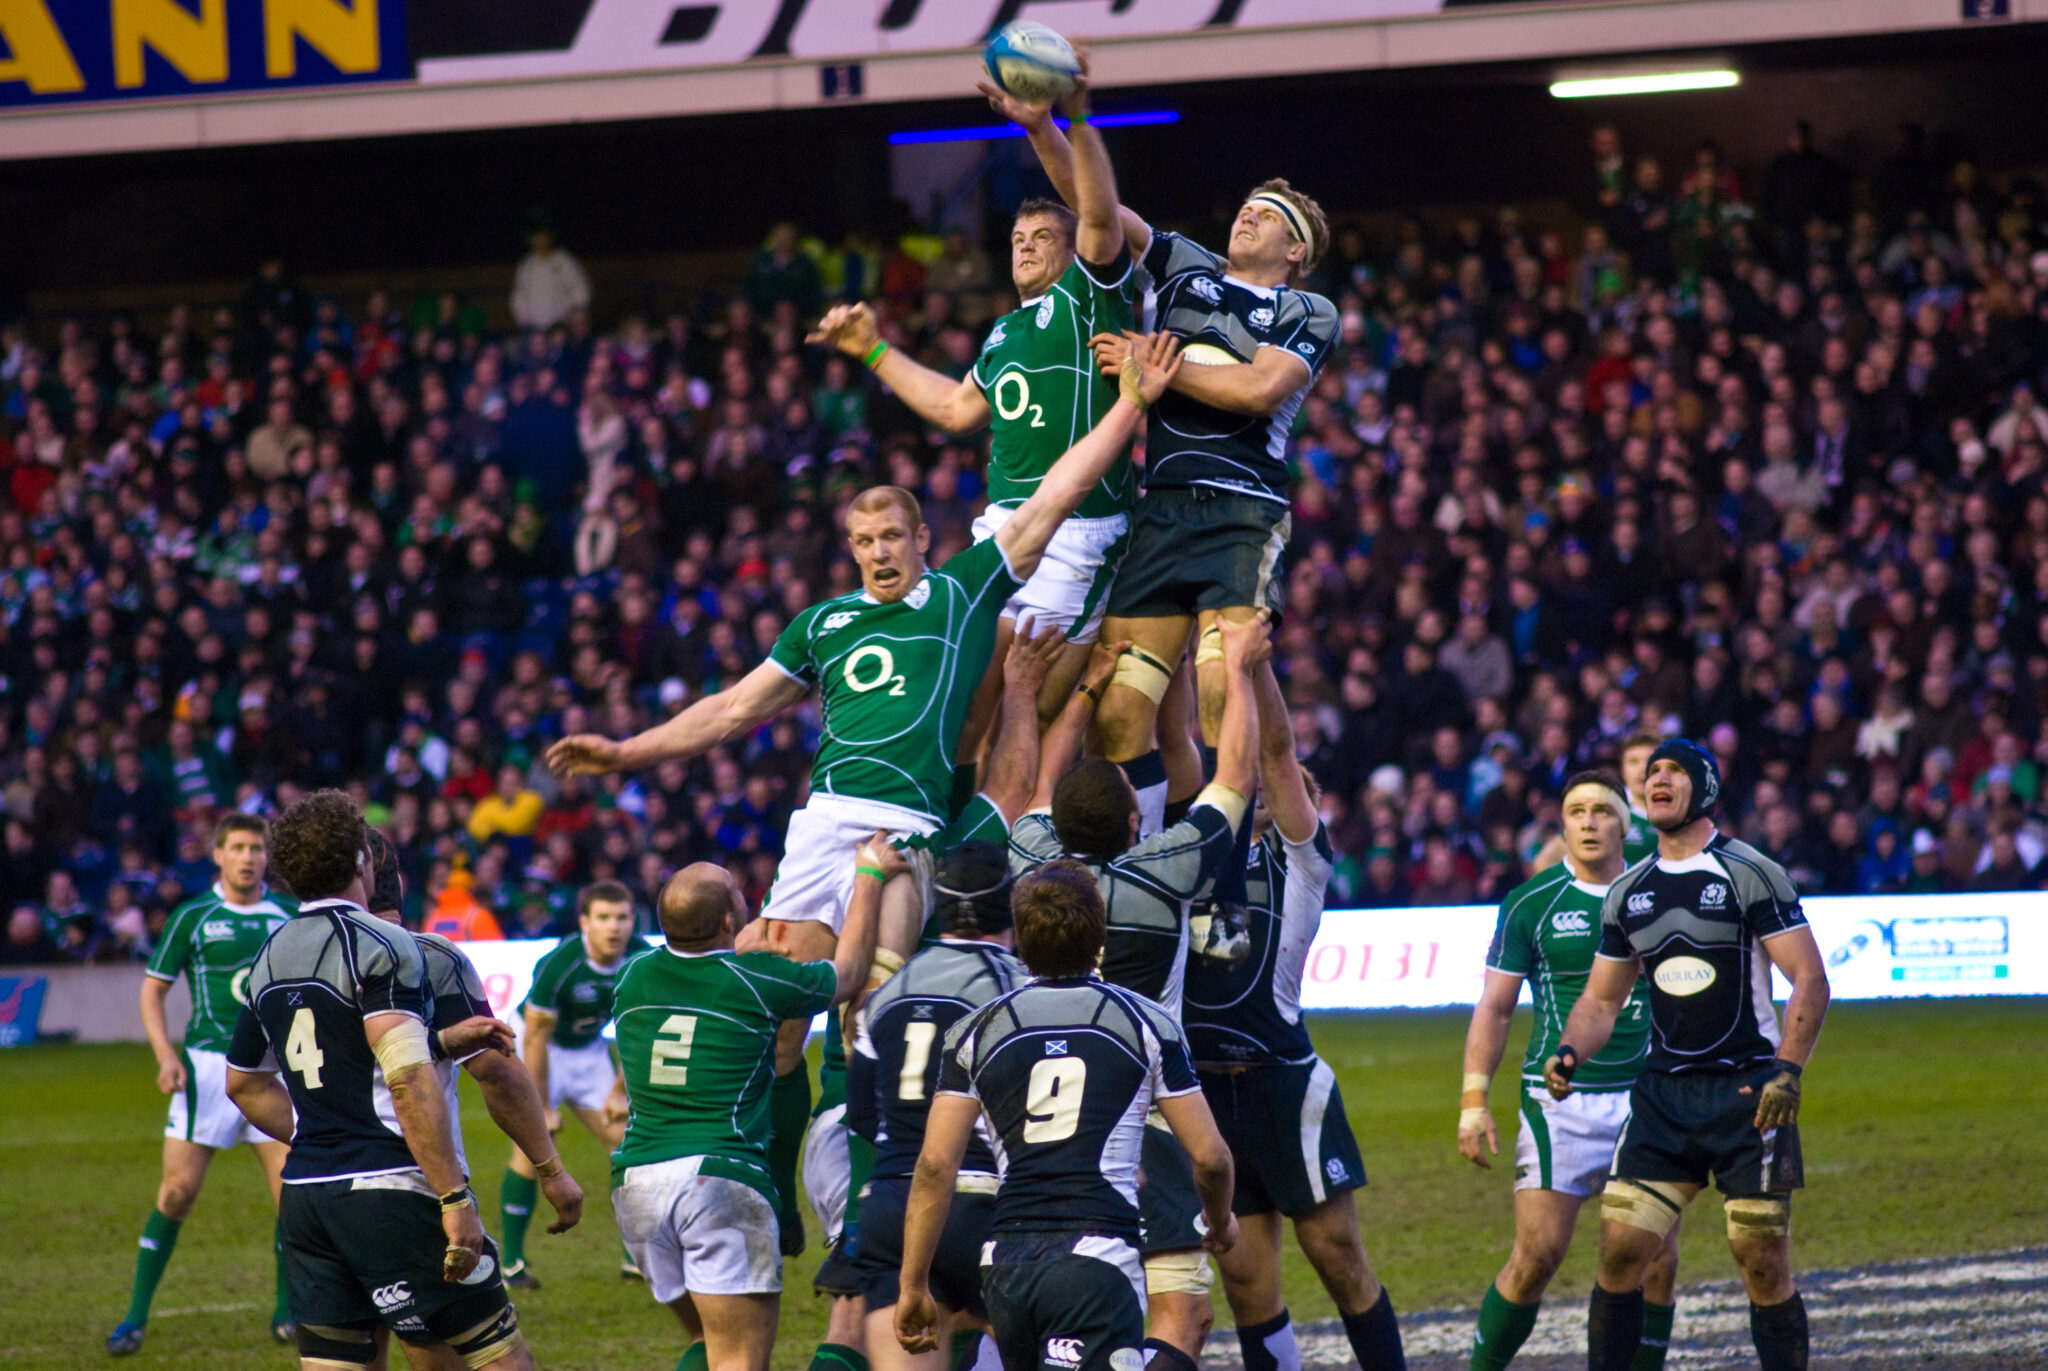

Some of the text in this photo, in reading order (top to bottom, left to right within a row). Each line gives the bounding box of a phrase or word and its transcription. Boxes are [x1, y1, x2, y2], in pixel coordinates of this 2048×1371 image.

[1310, 942, 1439, 984] 0131
[1656, 967, 1713, 983] MURRAY
[285, 1008, 324, 1089] 4
[650, 1014, 697, 1086] 2
[899, 1022, 938, 1100] 1
[1023, 1056, 1087, 1144] 9
